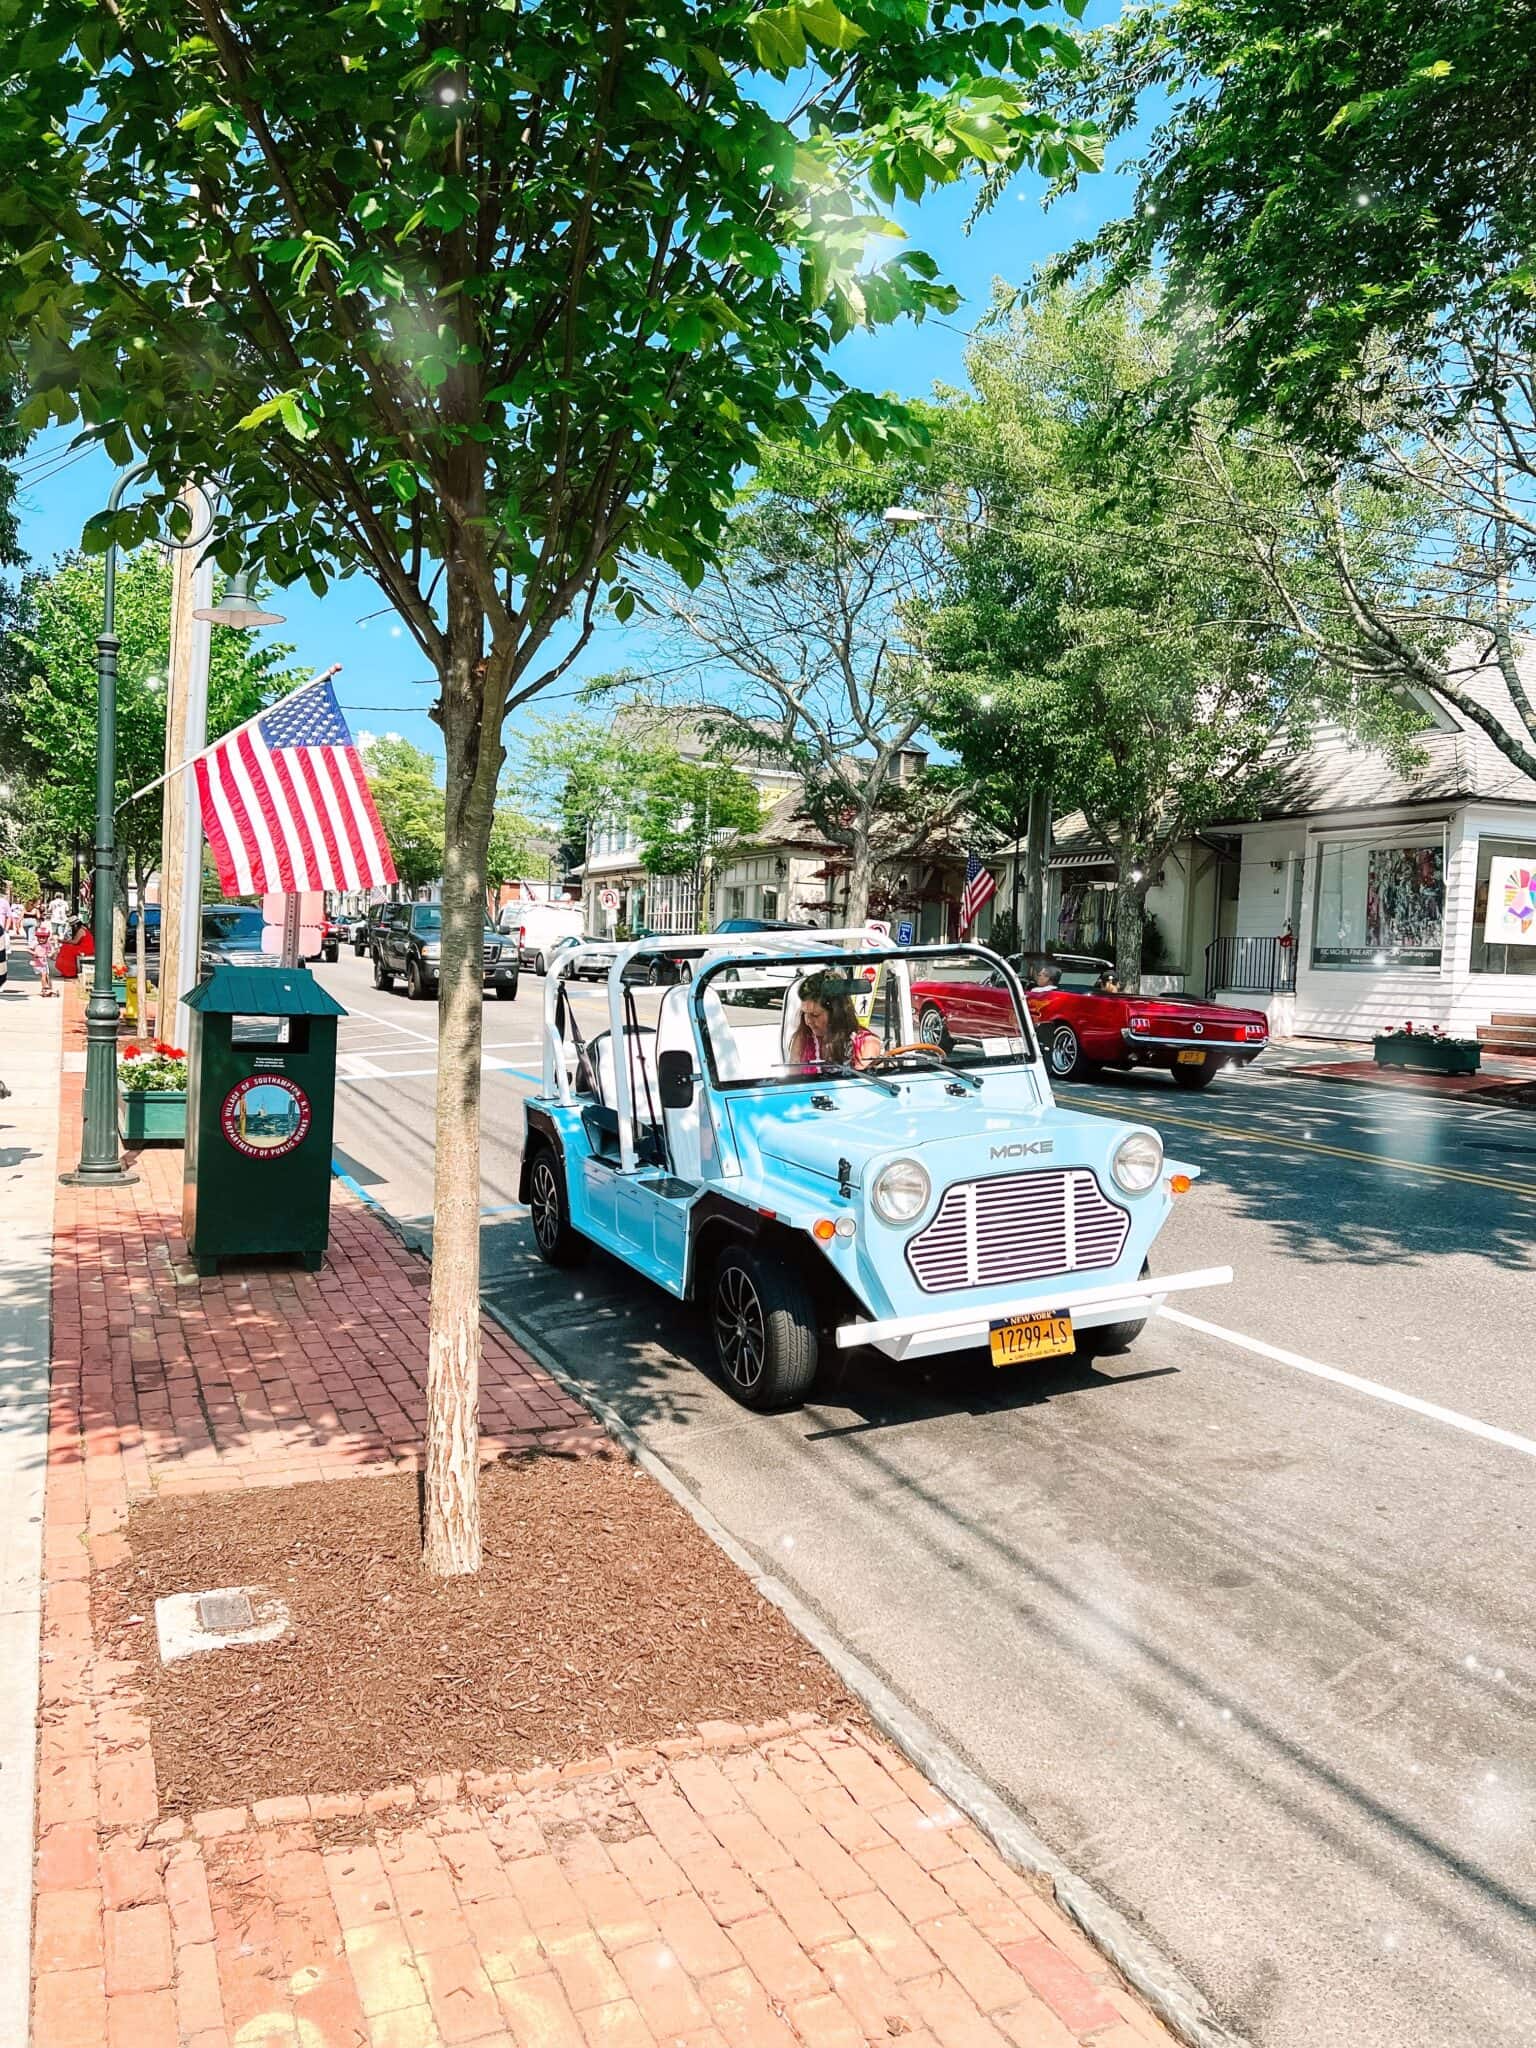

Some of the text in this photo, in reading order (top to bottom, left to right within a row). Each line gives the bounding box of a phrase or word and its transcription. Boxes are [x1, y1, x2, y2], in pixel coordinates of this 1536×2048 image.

[224, 1091, 240, 1117] VILLAGE
[241, 1082, 250, 1091] OF
[224, 1121, 258, 1155] DEPARTMENT
[270, 1140, 295, 1155] PUBLIC
[293, 1119, 309, 1141] WORKS
[990, 1140, 1054, 1160] MOKE
[1010, 1311, 1053, 1326] NEW YORK
